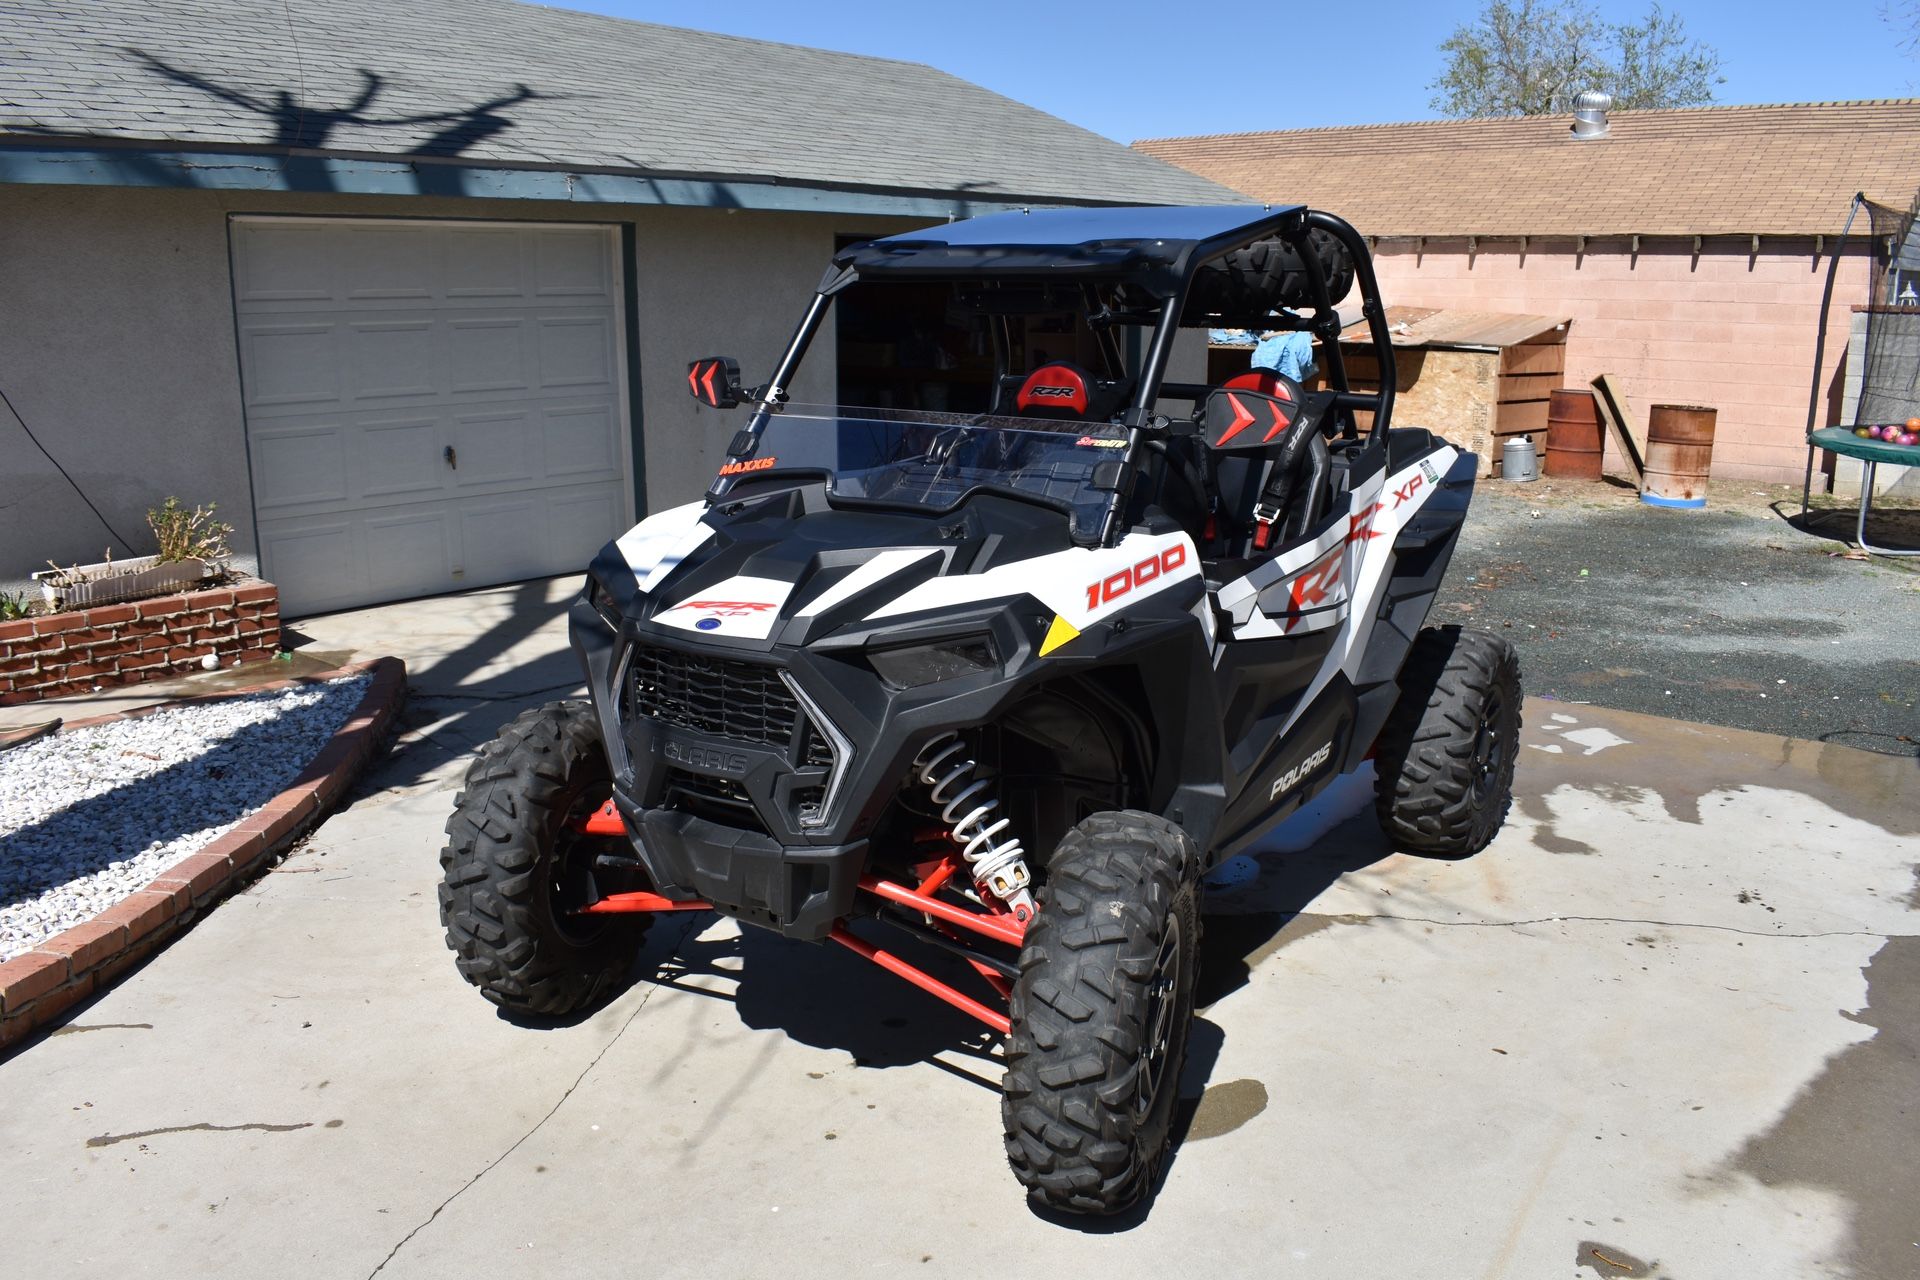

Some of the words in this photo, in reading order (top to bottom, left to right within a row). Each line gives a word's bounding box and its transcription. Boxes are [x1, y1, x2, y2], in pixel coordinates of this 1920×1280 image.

[1029, 385, 1076, 398] RZR
[1288, 416, 1309, 450] RZR
[719, 456, 777, 476] MAXXIS
[1392, 473, 1423, 510] XP
[1086, 542, 1186, 612] 1000
[667, 600, 777, 612] RZR
[1269, 741, 1332, 801] POLARIS
